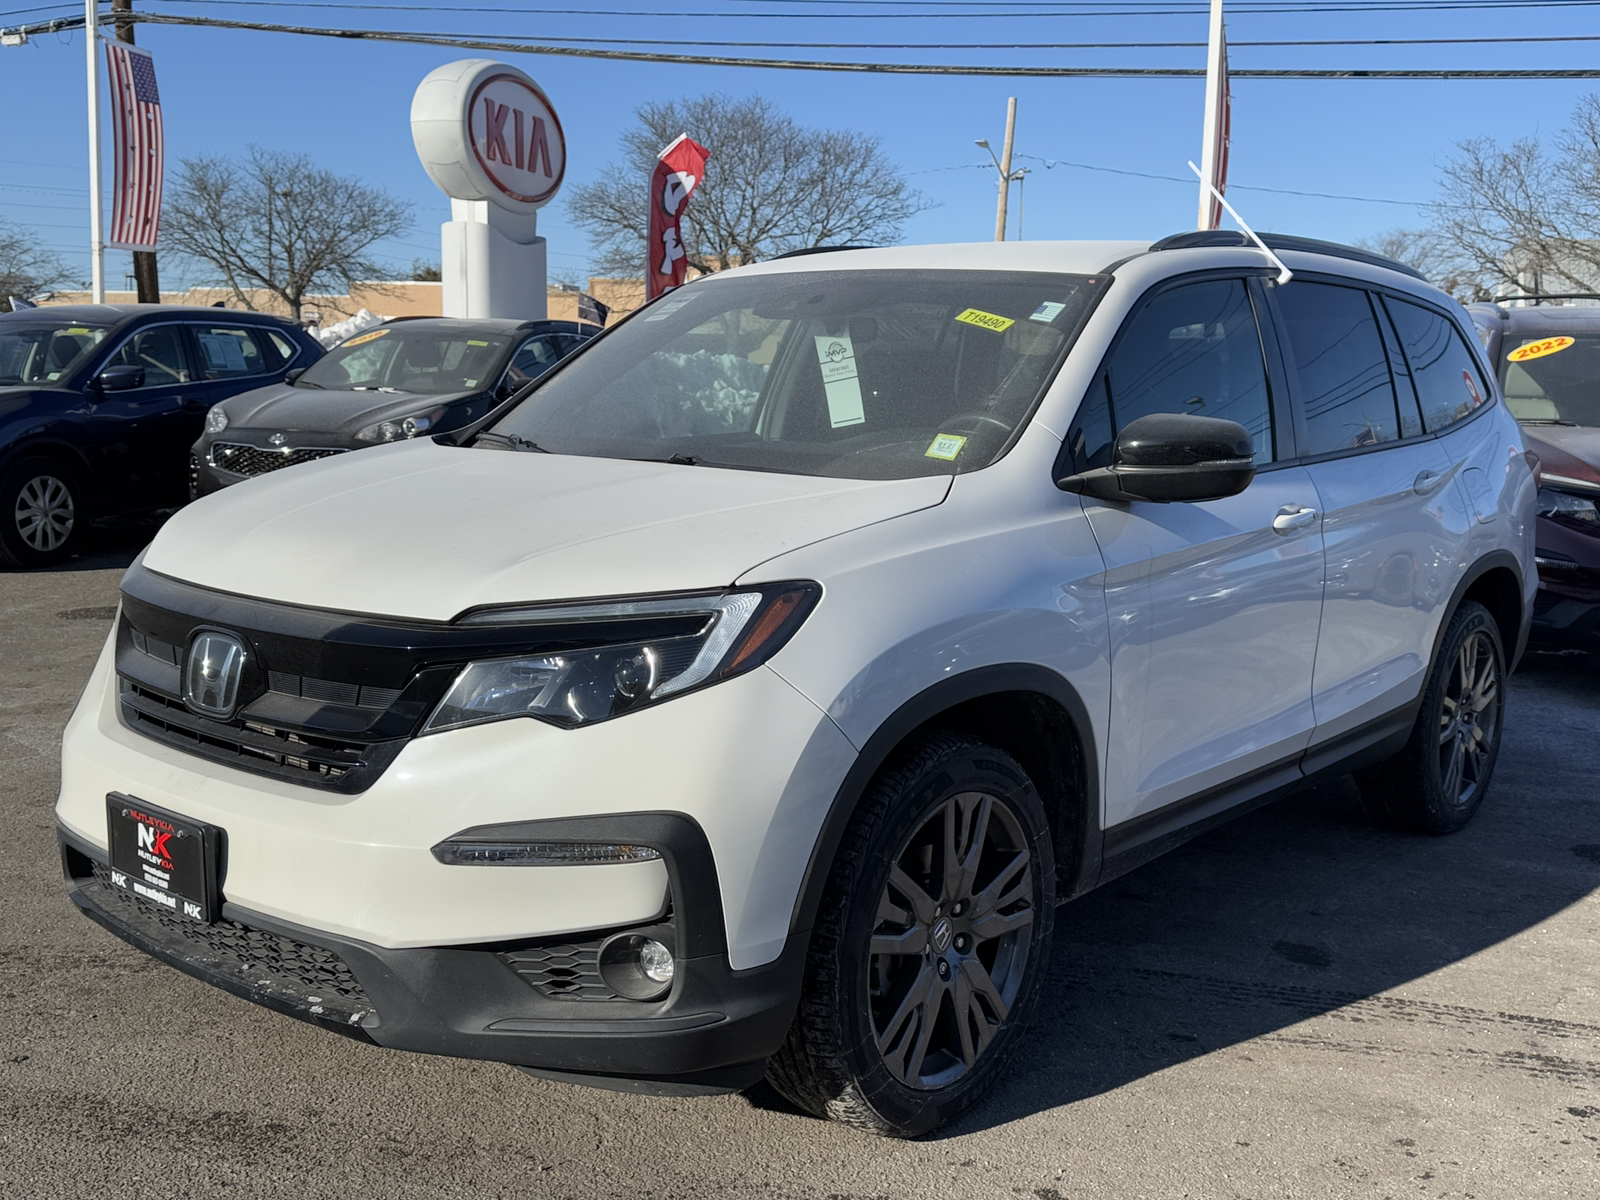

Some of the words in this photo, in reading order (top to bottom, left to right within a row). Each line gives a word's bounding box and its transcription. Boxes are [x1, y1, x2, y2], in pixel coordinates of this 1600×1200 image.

[484, 97, 553, 178] KIA
[965, 310, 1005, 329] T19490
[1516, 337, 1569, 359] 2022
[111, 871, 127, 888] NK
[183, 902, 202, 919] NK
